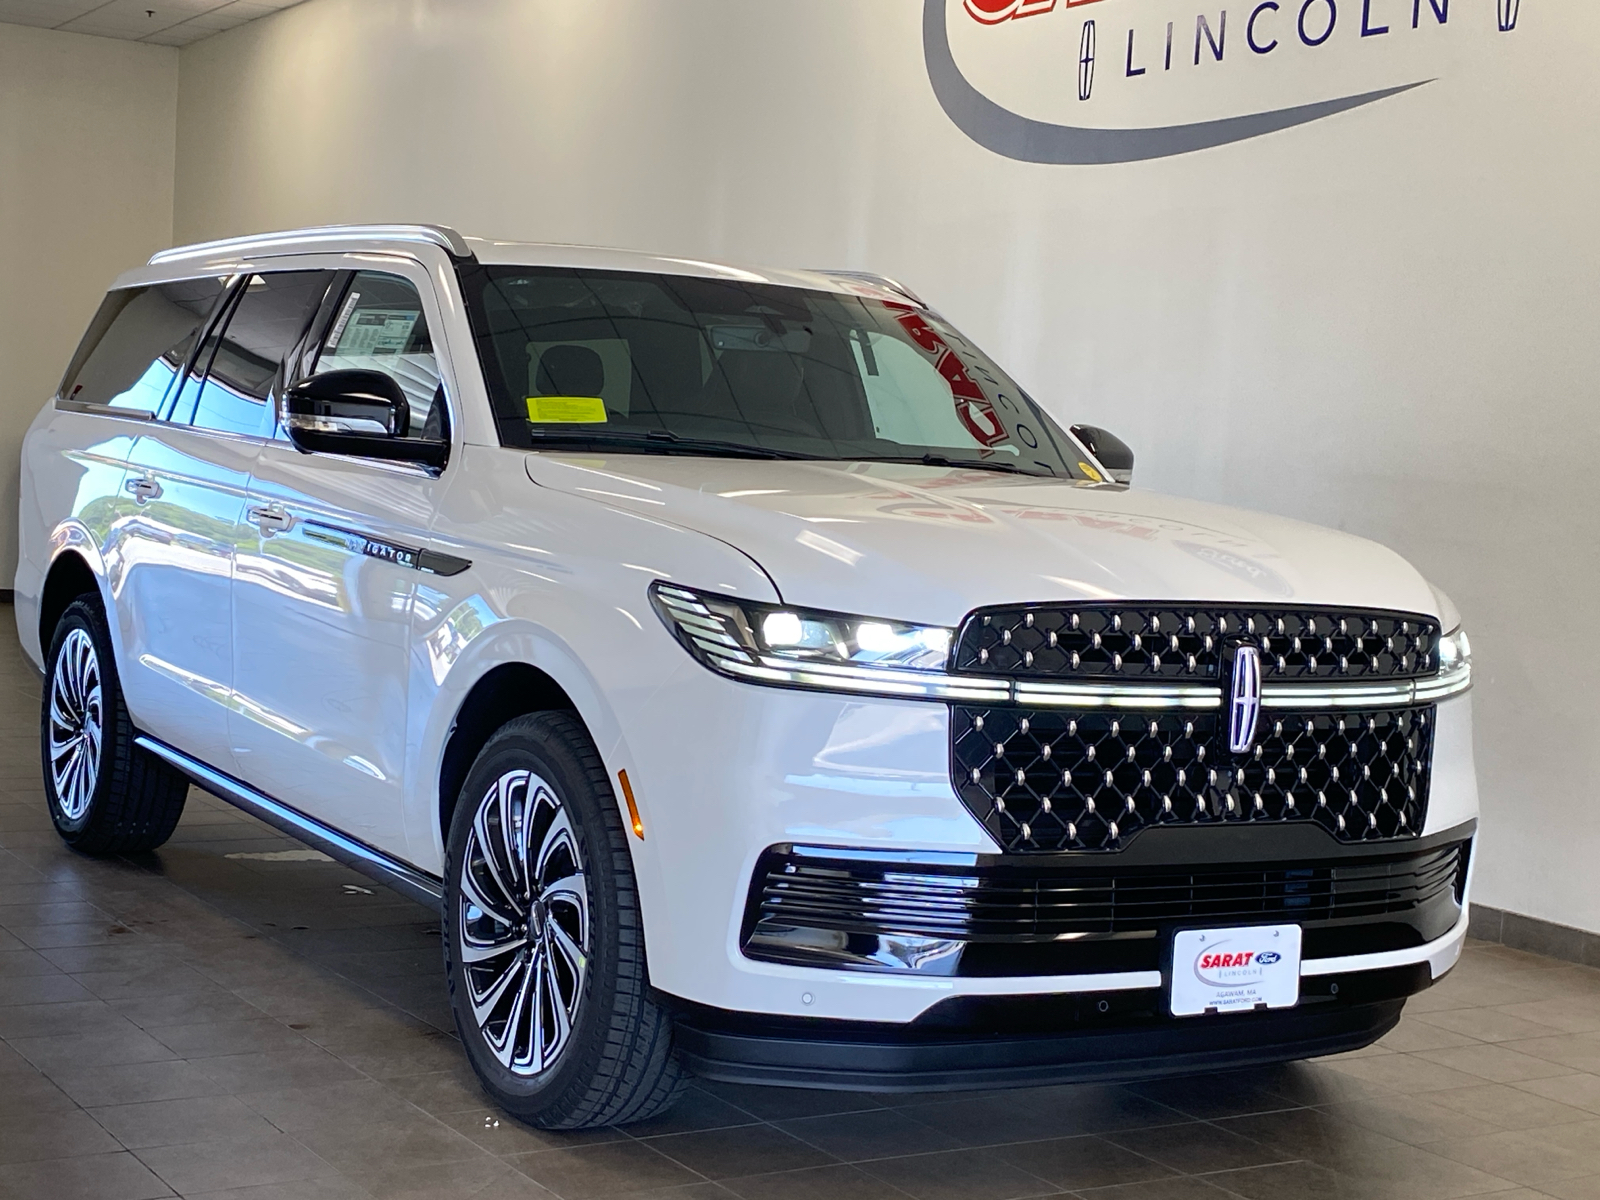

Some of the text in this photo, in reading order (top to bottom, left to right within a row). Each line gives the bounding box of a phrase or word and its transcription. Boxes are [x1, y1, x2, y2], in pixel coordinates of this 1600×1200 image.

[1201, 952, 1280, 969] SARAT Ford
[1224, 969, 1257, 977] LINCOLN
[1216, 990, 1246, 998] AGAWAM,
